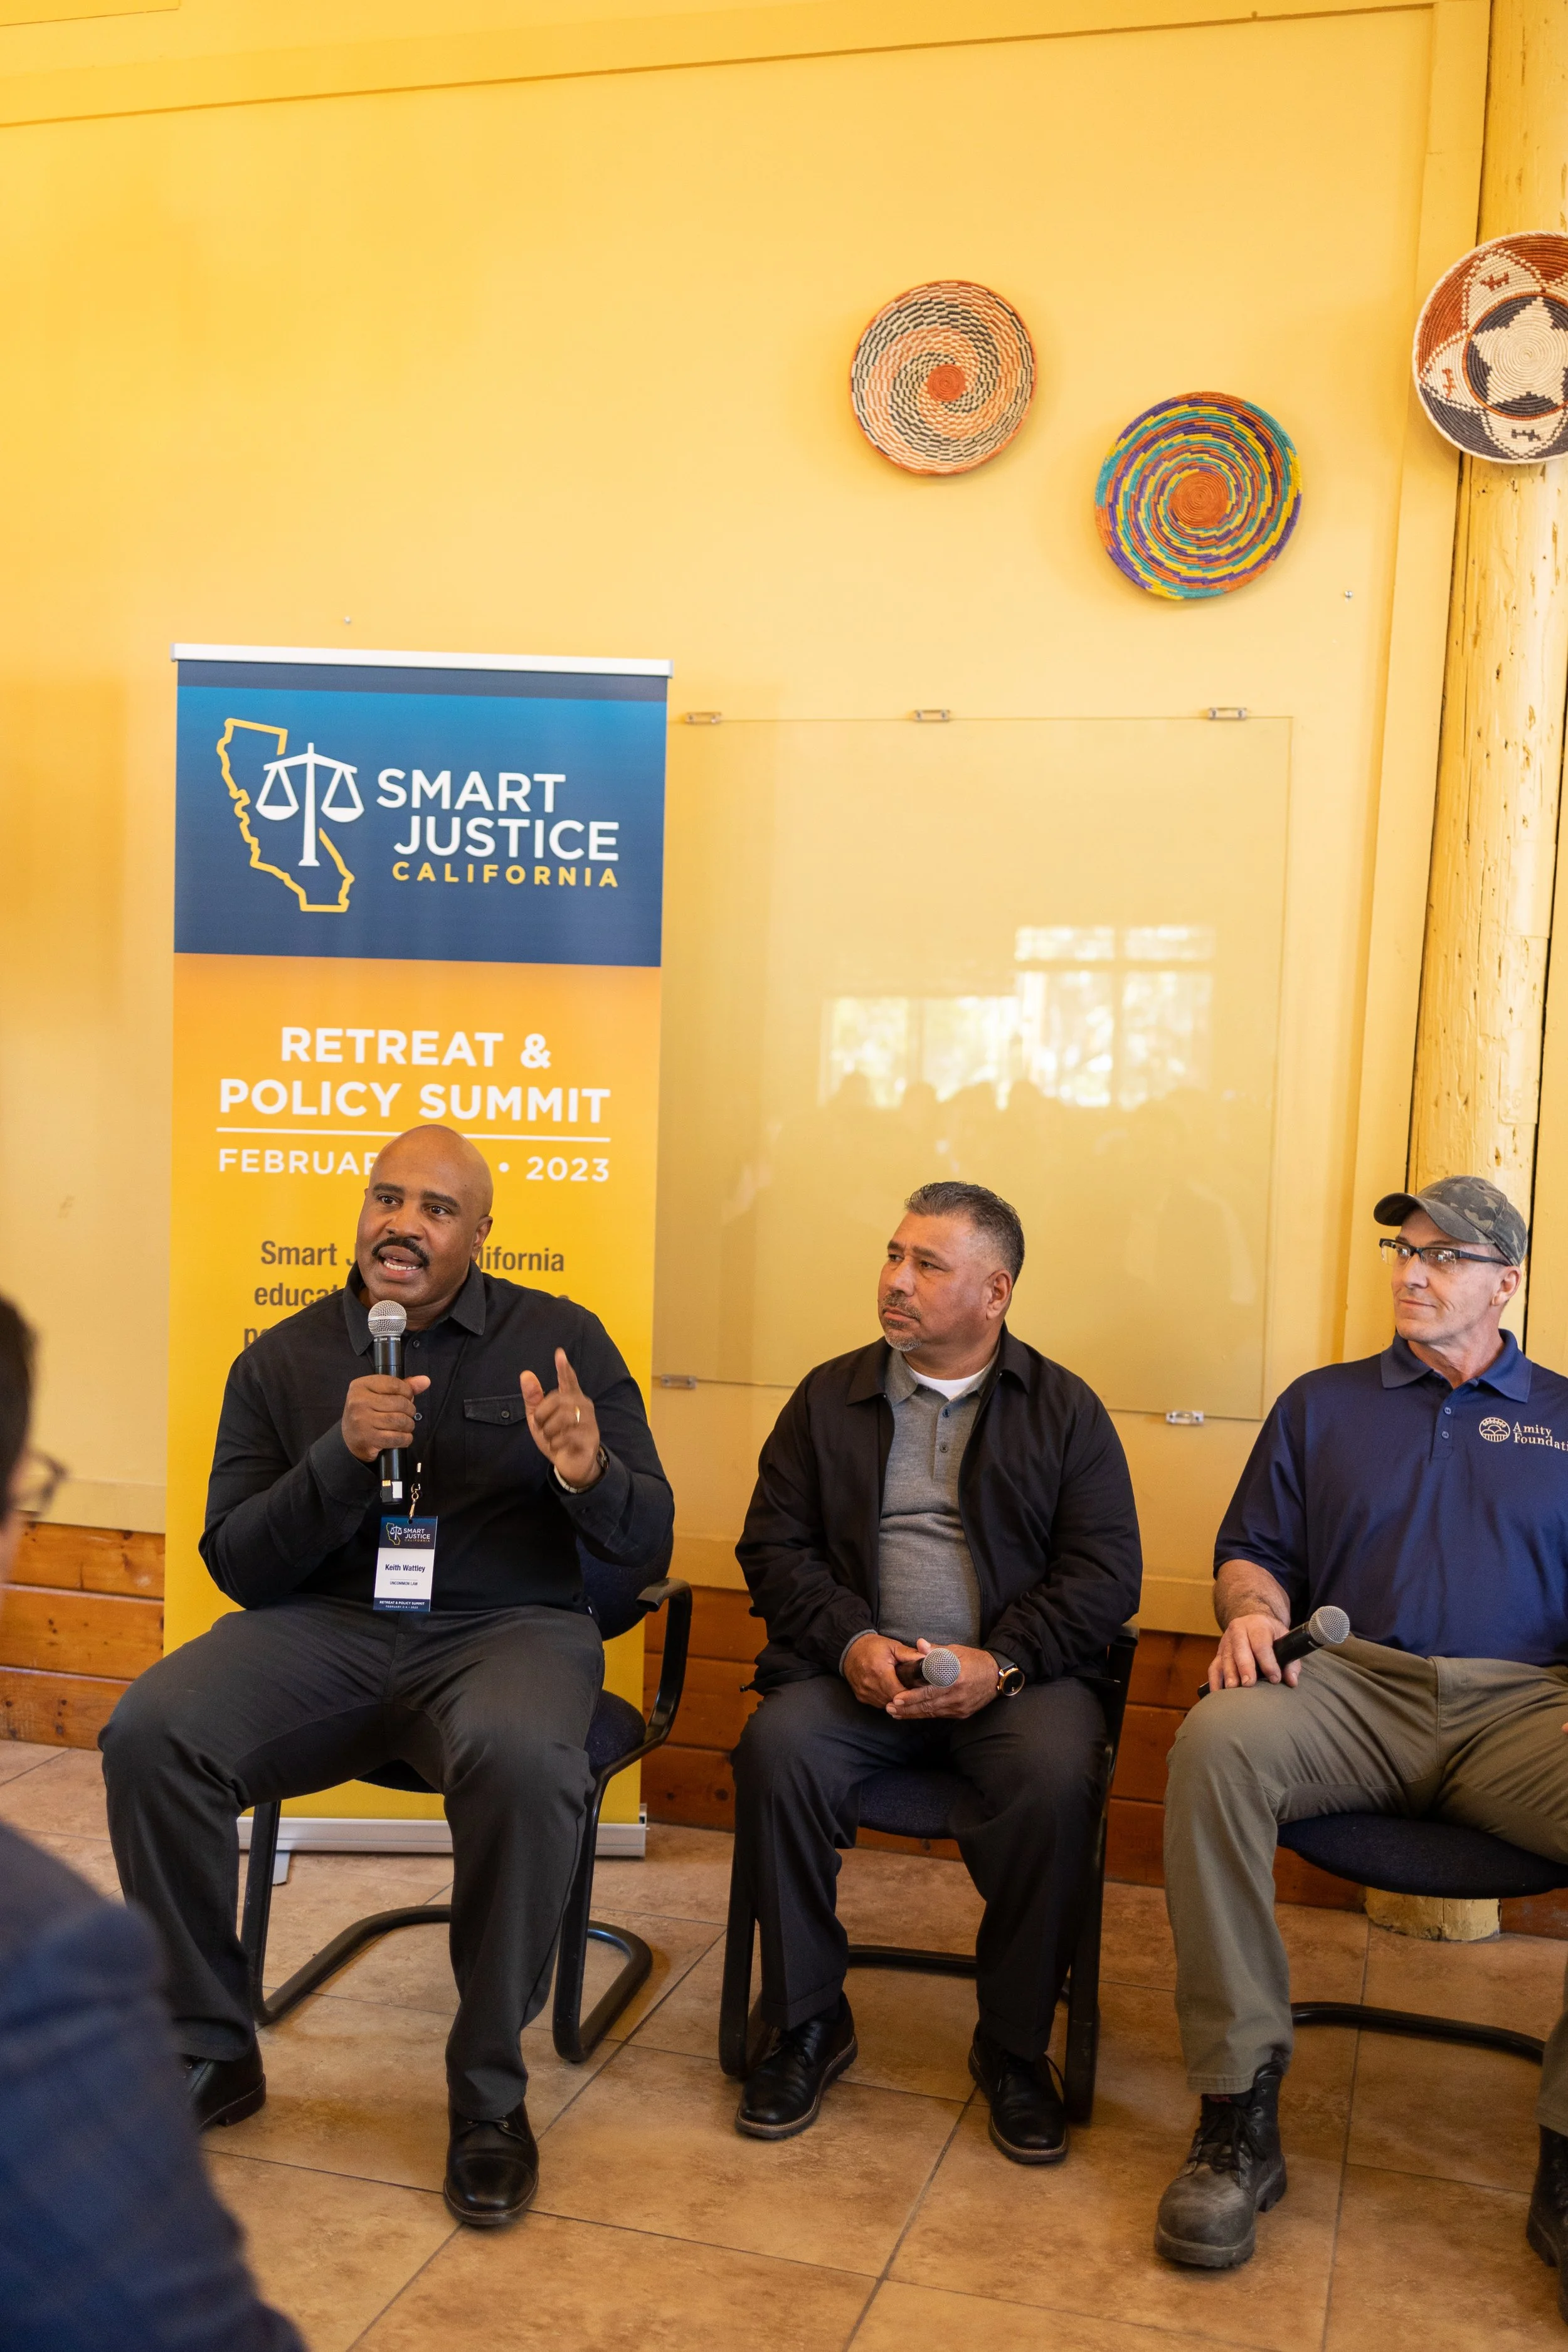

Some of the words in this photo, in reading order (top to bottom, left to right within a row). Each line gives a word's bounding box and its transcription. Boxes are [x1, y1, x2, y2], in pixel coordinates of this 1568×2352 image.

[376, 768, 566, 813] SMART
[393, 815, 619, 861] JUSTICE
[392, 861, 618, 888] CALIFORNIA
[281, 1026, 504, 1067] RETREAT
[520, 1033, 551, 1069] &
[220, 1078, 402, 1117] POLICY
[419, 1083, 612, 1123] SUMMIT
[526, 1156, 609, 1182] 2023
[260, 1240, 337, 1266] Smart
[479, 1246, 564, 1272] lifornia
[1512, 1421, 1552, 1438] Amity
[403, 1564, 426, 1573] Wattley
